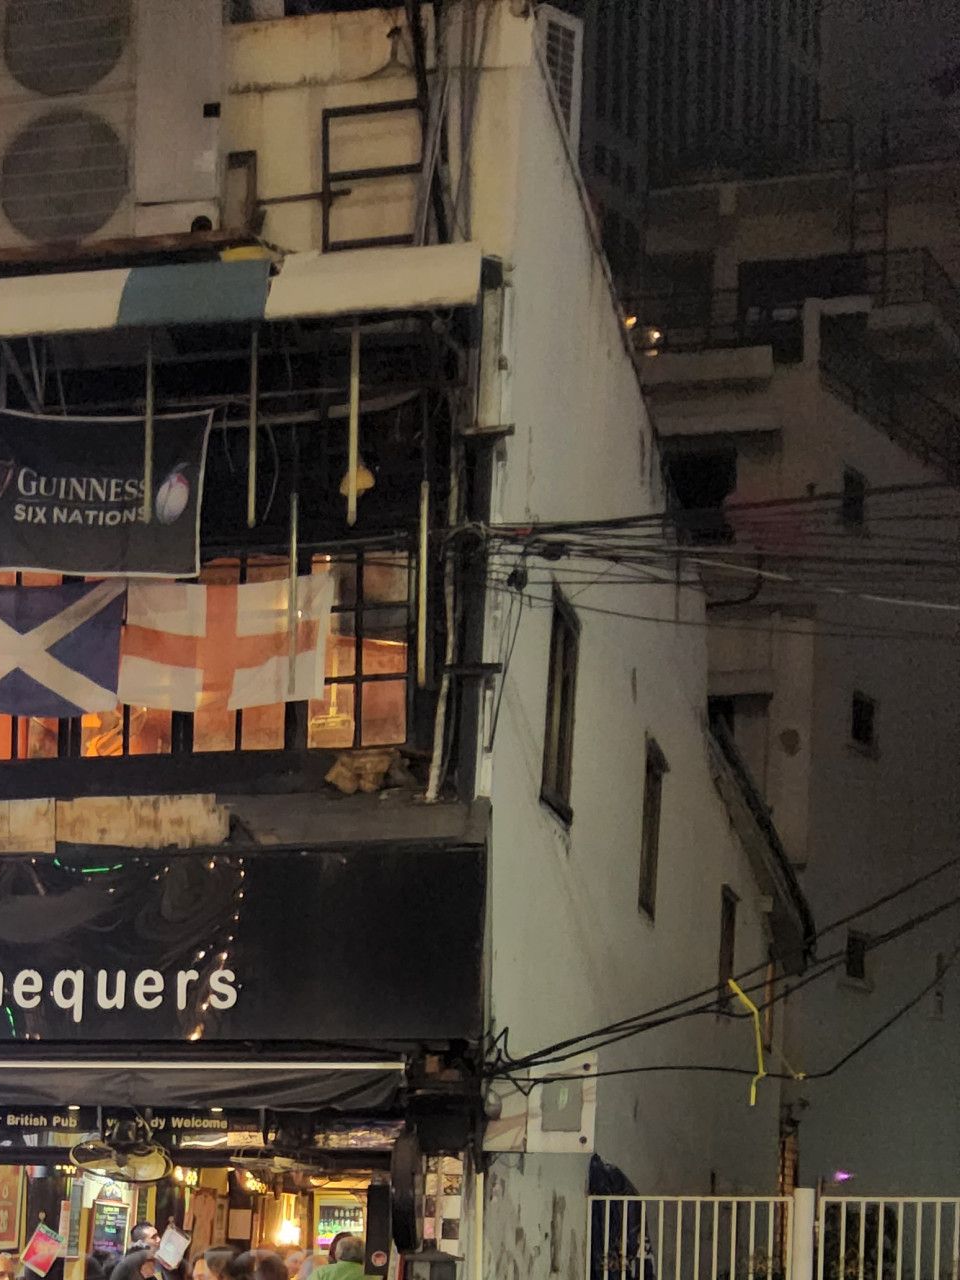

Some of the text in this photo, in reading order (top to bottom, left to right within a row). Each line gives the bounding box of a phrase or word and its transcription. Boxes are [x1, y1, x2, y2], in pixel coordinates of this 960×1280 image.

[14, 503, 145, 526] SIX NATIONS
[6, 1114, 47, 1127] British
[52, 1115, 78, 1128] Pub
[171, 1116, 227, 1129] Welcome
